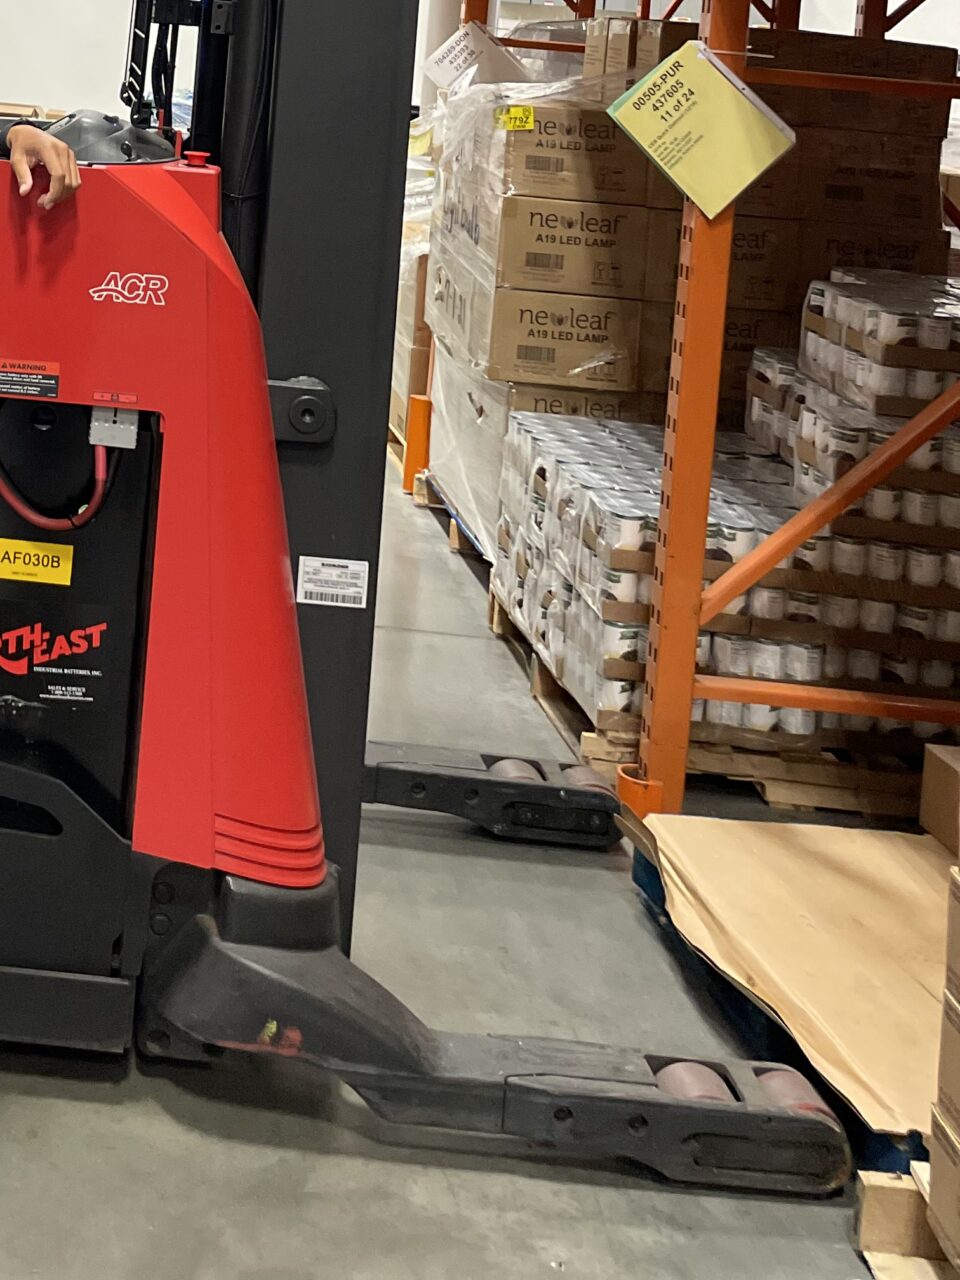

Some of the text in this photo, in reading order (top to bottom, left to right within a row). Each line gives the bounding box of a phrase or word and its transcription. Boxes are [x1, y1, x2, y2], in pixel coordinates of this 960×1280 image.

[632, 60, 685, 111] 00505-PUR
[651, 79, 684, 113] 437605
[660, 88, 696, 123] 11 of 24
[509, 116, 529, 125] 779Z
[536, 139, 617, 153] A19 LED LAMP
[535, 234, 617, 248] A19 LED LAMP
[89, 272, 168, 305] ACR
[527, 329, 608, 343] A19 LED LAMP
[9, 362, 47, 371] WARNING
[0, 550, 61, 569] AF030B
